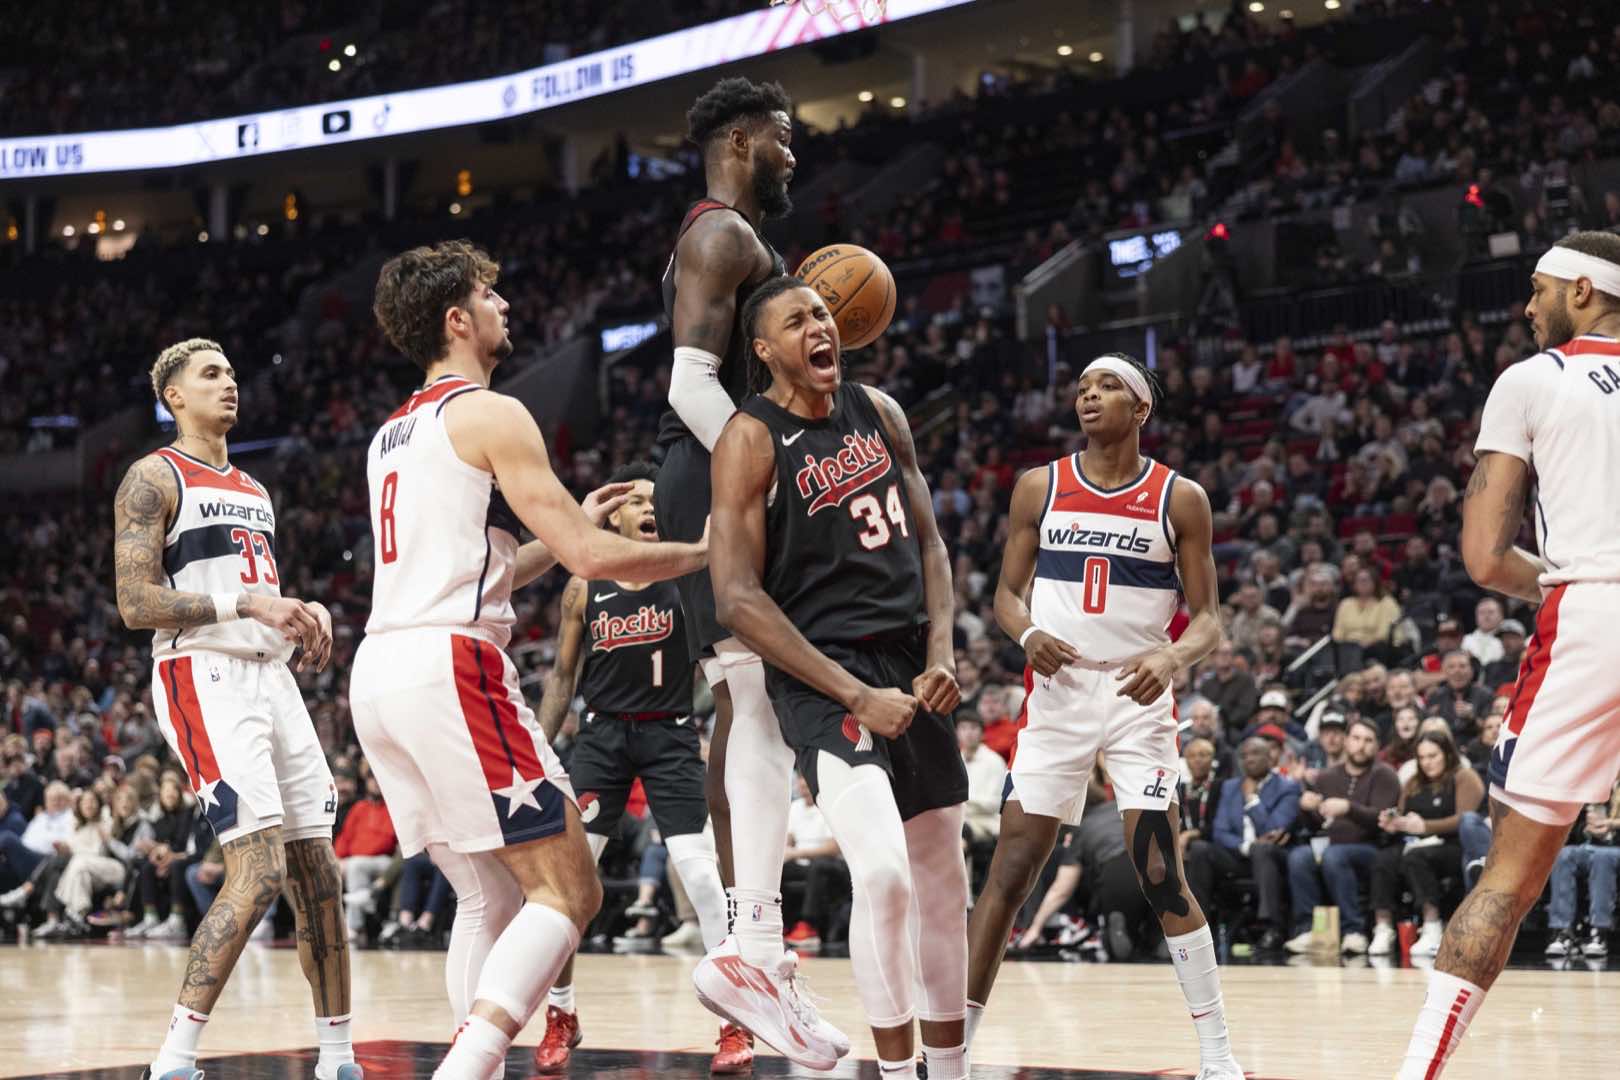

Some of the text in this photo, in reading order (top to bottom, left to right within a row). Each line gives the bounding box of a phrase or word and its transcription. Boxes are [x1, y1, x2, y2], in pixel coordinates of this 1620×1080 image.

[611, 54, 634, 82] US
[56, 143, 83, 166] US
[796, 429, 891, 517] ripcity
[380, 471, 398, 564] 8
[849, 484, 909, 550] 34
[1047, 523, 1153, 554] wizards
[231, 528, 280, 586] 33
[1082, 556, 1111, 616] 0
[591, 604, 673, 653] ripcity
[650, 648, 664, 688] 1
